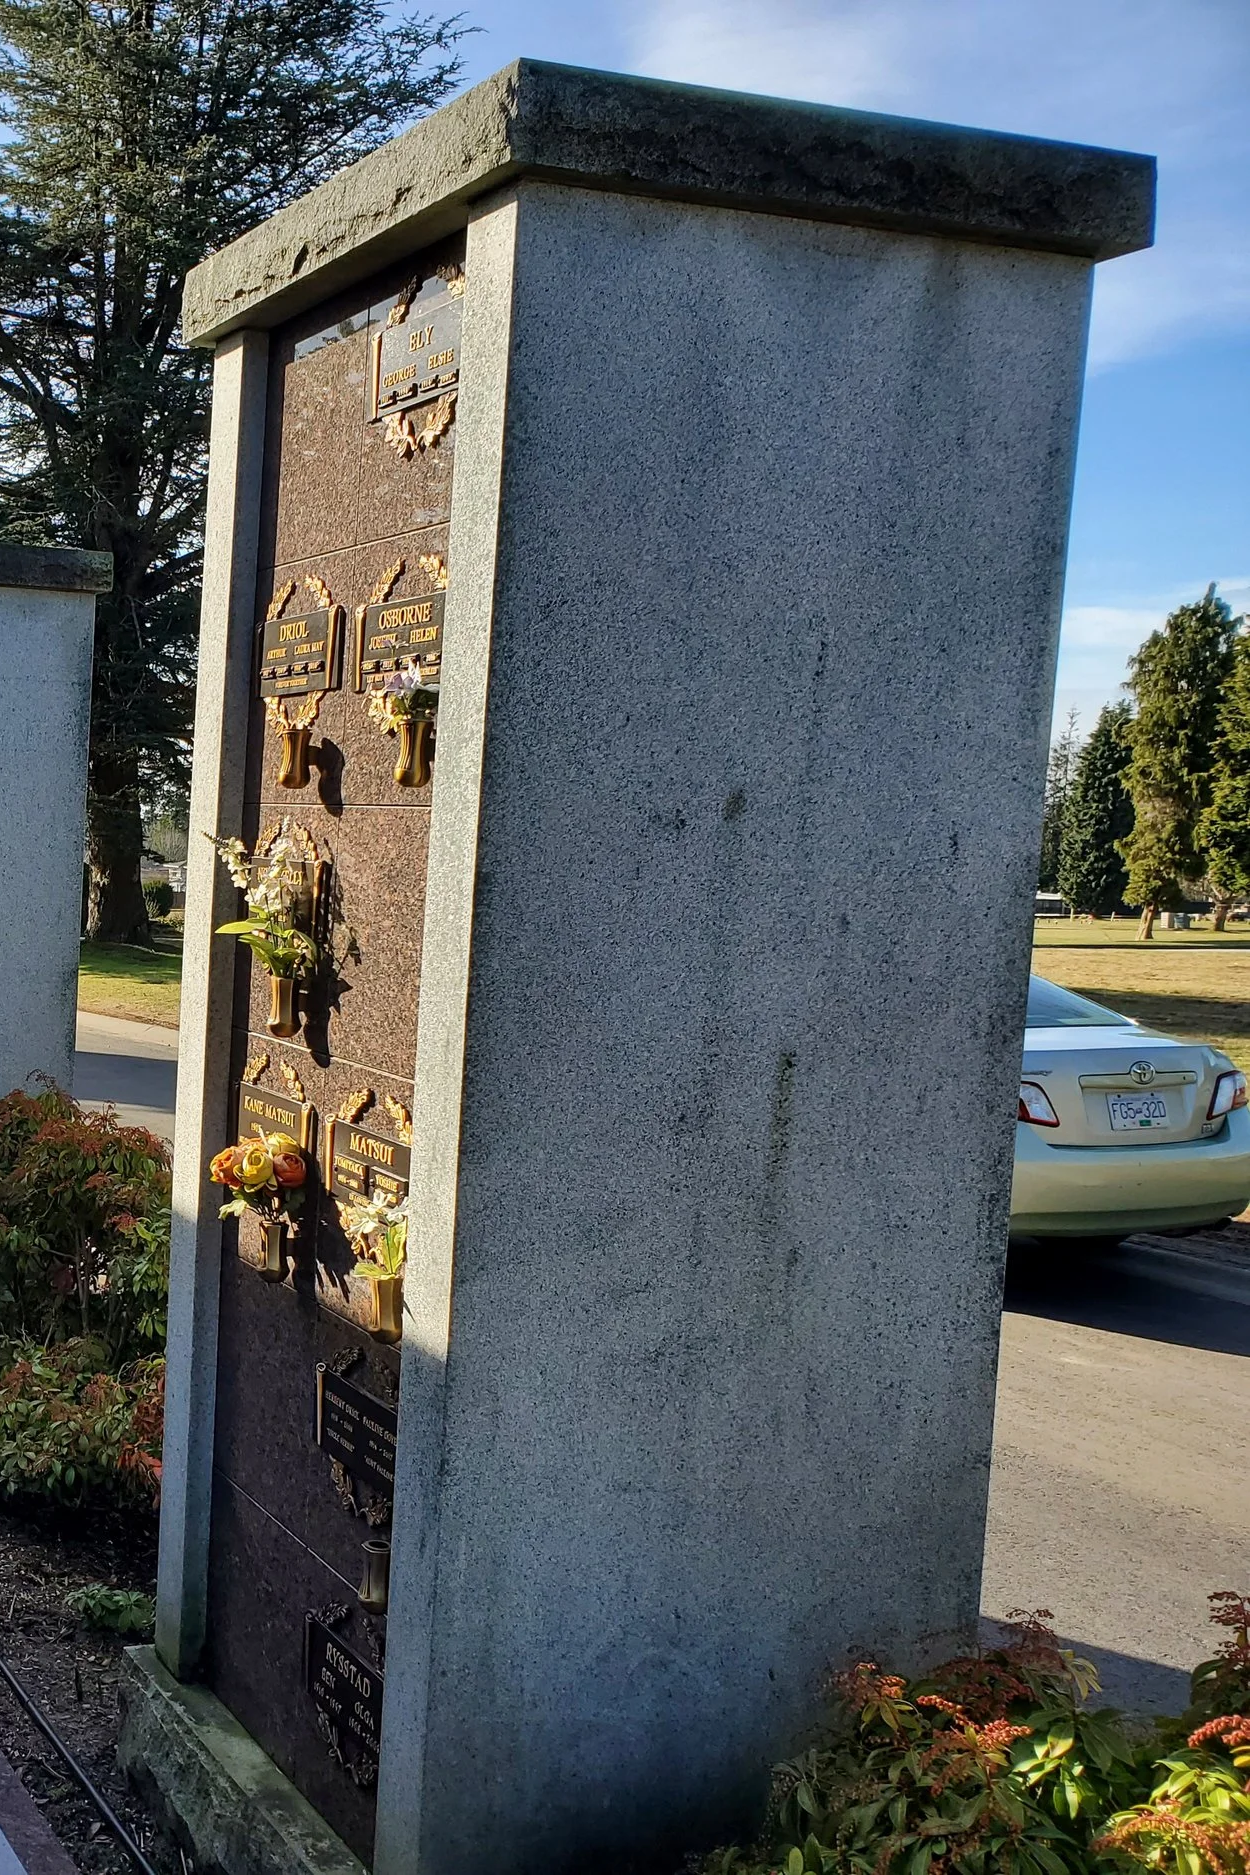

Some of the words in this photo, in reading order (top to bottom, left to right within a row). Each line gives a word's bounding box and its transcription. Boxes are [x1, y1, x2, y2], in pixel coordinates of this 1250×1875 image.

[409, 324, 434, 352] ELY
[382, 364, 416, 388] GEORGE
[428, 347, 454, 371] ELSIE
[379, 602, 432, 629] OSBORNE
[279, 621, 309, 642] DRIOL
[410, 625, 438, 643] HELEN
[244, 1095, 264, 1115] KANE
[265, 1103, 296, 1128] MATSUI
[350, 1132, 395, 1165] MATSUI
[321, 1667, 336, 1689] BEN
[326, 1642, 371, 1698] RYSSTAD
[354, 1701, 374, 1731] OLGA
